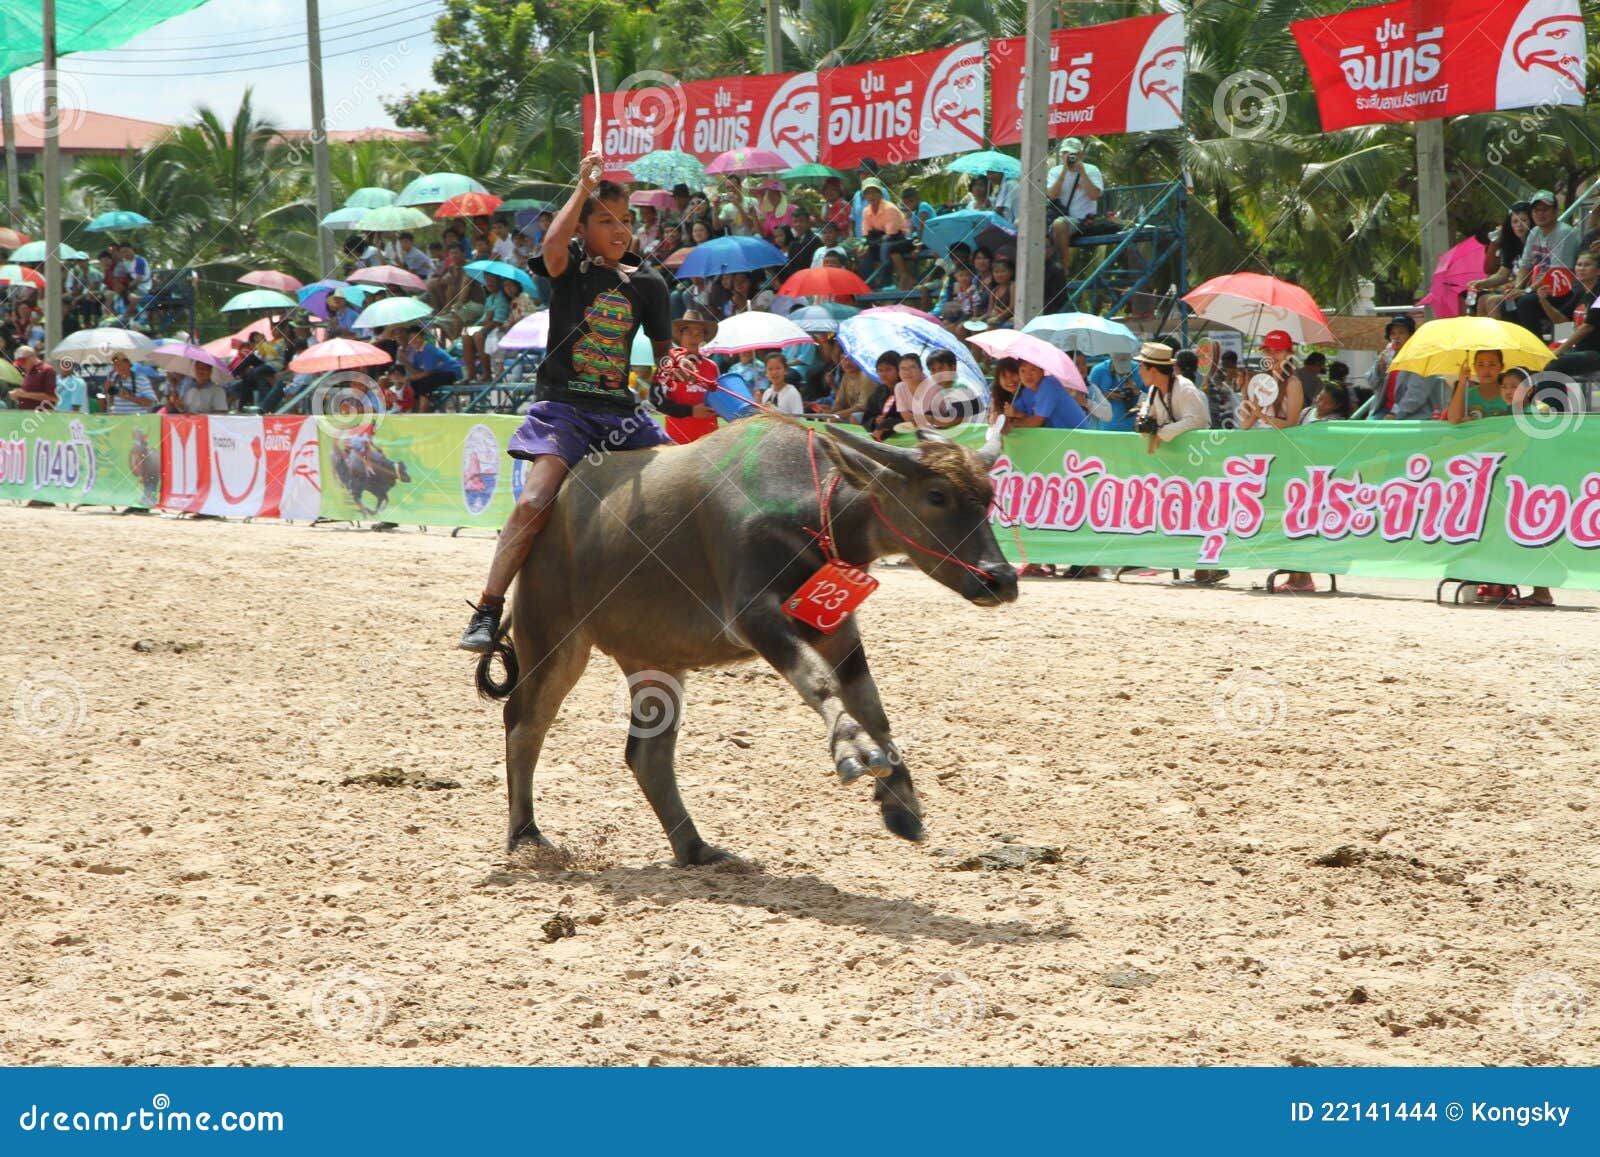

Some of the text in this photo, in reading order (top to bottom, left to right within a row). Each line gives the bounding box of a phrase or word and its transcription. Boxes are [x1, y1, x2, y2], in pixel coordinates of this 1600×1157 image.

[1339, 26, 1444, 91] อินทรี
[1376, 18, 1405, 49] ปูน
[861, 70, 885, 100] ปูน
[693, 100, 753, 153] อินทรี
[828, 81, 912, 145] อินทรี
[989, 451, 1272, 563] ังหวัดชลบุรี
[1282, 452, 1505, 544] ประจำปี
[807, 580, 850, 611] 123
